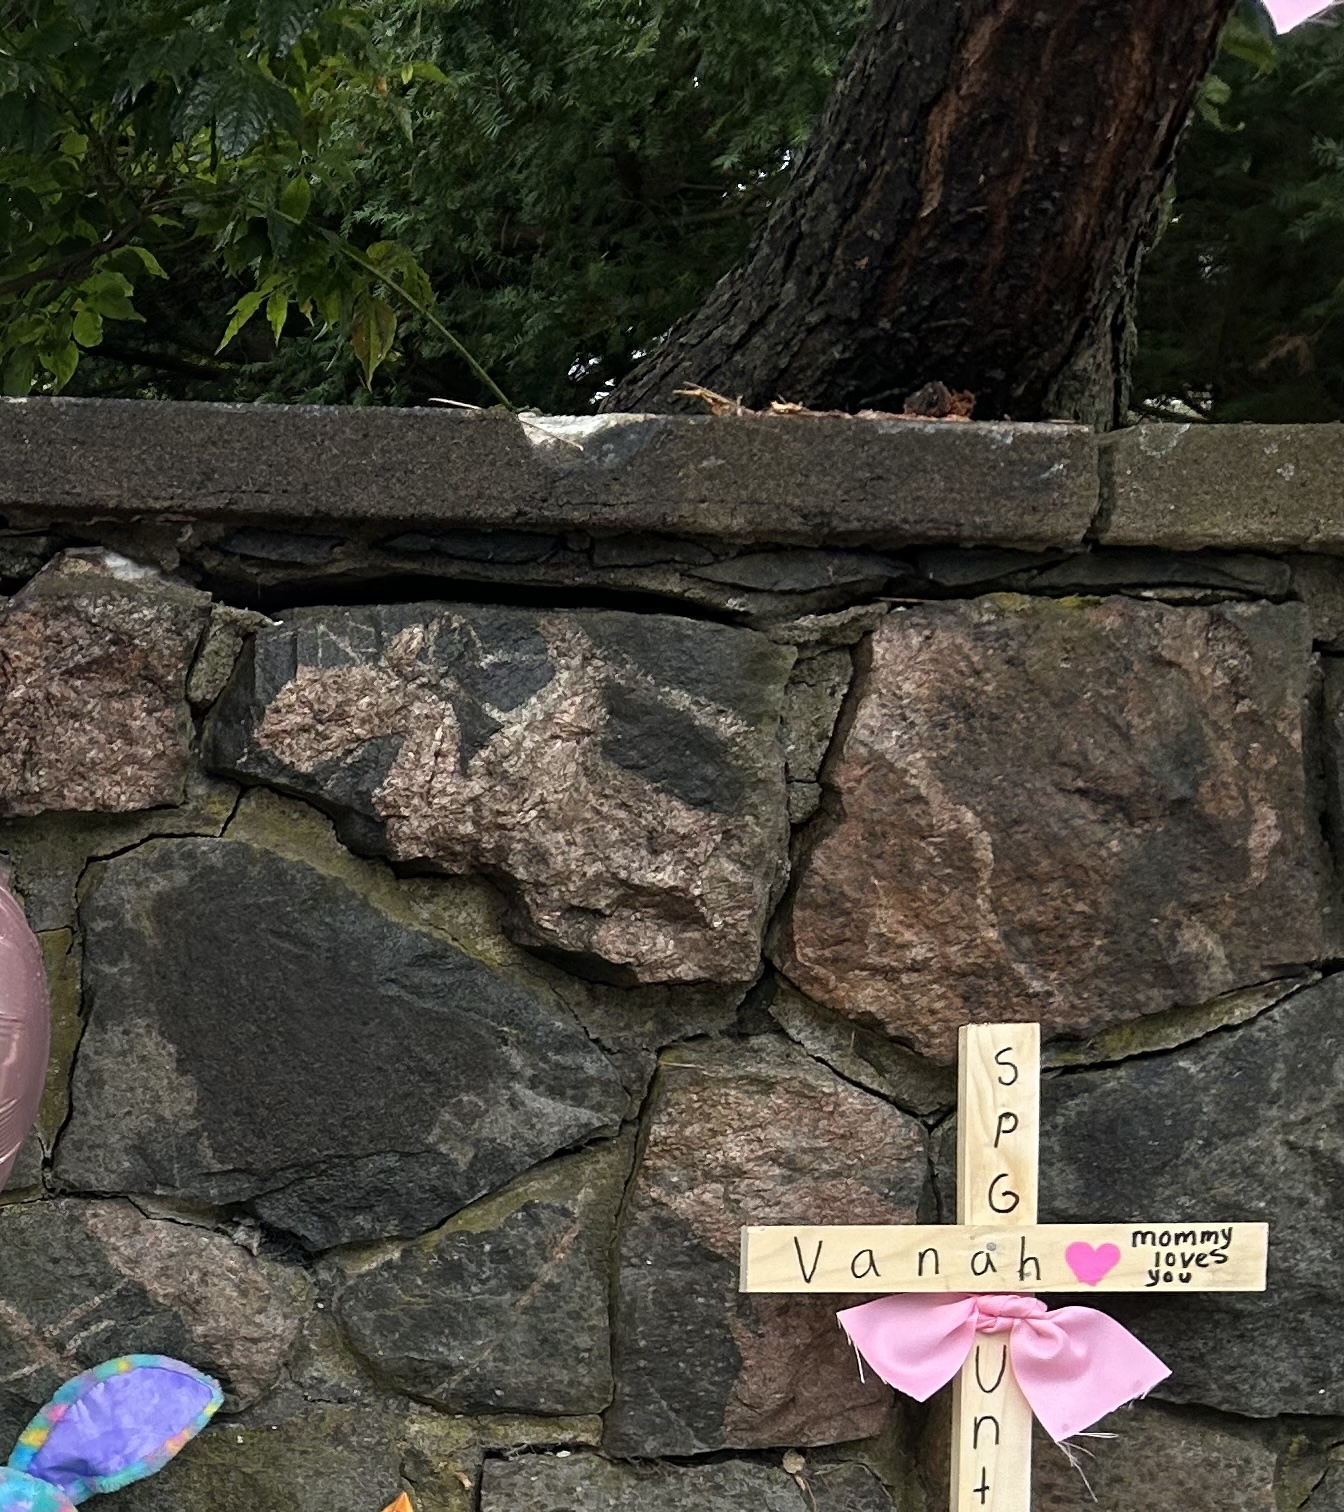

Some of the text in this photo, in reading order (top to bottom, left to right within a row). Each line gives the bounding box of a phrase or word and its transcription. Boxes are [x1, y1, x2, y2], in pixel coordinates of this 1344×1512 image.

[1130, 1226, 1234, 1250] mommy
[793, 1235, 1042, 1285] Vanah
[1145, 1268, 1193, 1288] you
